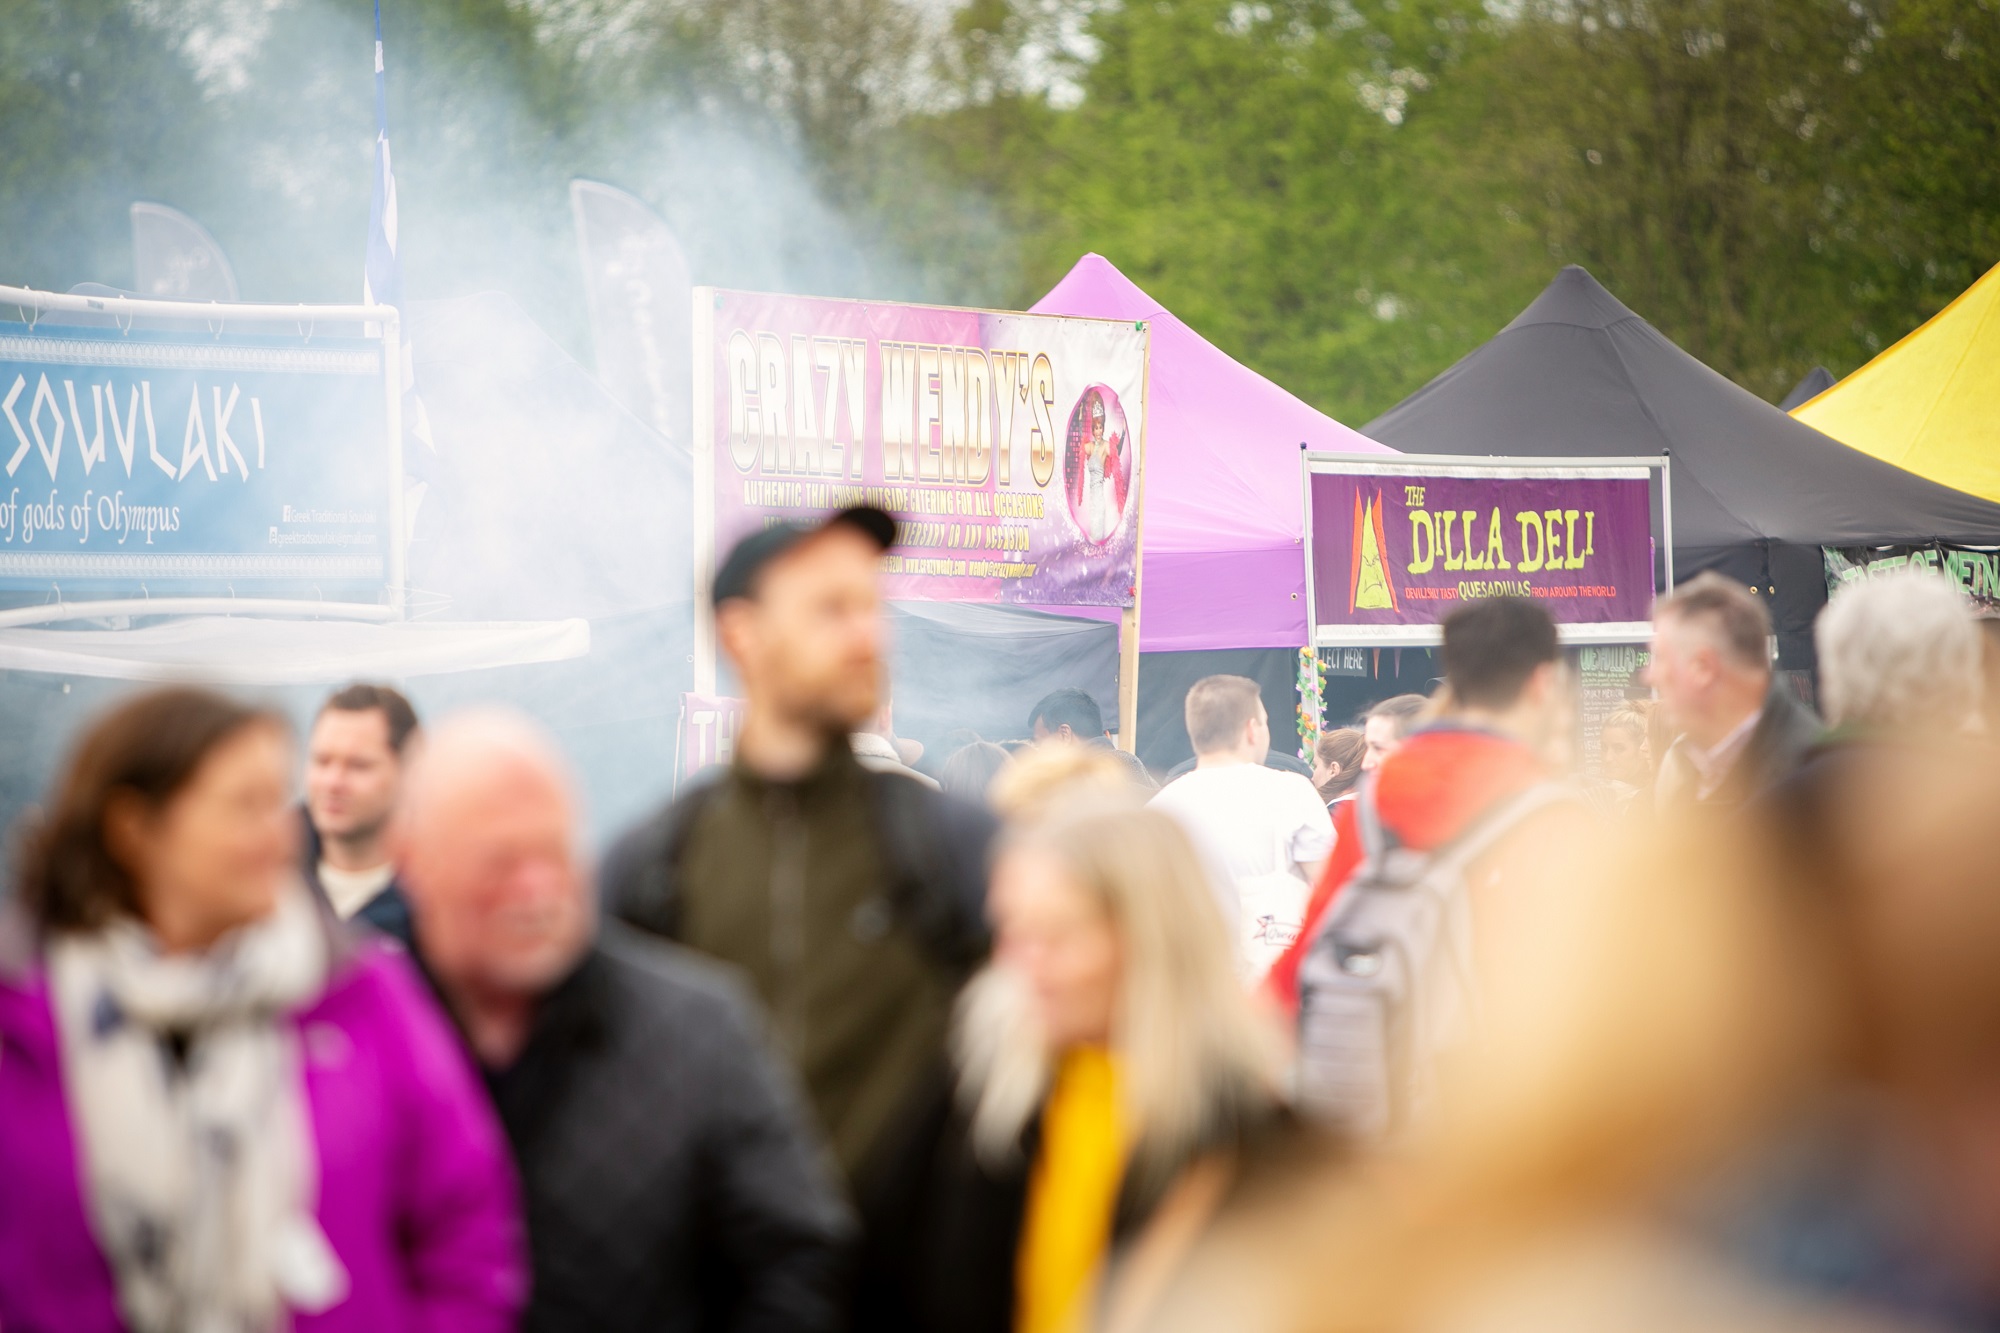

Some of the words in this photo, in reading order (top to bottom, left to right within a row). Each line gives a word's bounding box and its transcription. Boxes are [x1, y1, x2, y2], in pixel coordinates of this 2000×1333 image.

[728, 328, 867, 480] CRAZY
[879, 339, 1055, 488] WENDY'S
[2, 371, 265, 483] SOUVLAKI
[743, 480, 802, 507] AUTHENTIC
[805, 482, 829, 509] THAI
[832, 484, 864, 510] CUISINE
[866, 486, 908, 512] OUTSIDE
[910, 488, 954, 515] CATERING
[955, 490, 973, 517] FOR
[975, 491, 992, 517] ALL
[994, 492, 1045, 519] OCCASIONS
[1405, 485, 1425, 507] THE
[0, 487, 20, 543] of
[22, 488, 65, 544] gods
[71, 489, 93, 544] of
[97, 490, 180, 545] Olympus
[291, 508, 310, 523] Greek
[311, 508, 348, 523] Traditional
[947, 523, 961, 549] OR
[963, 523, 982, 550] ANY
[984, 524, 1030, 551] OCCASION
[1407, 506, 1512, 575] DILLA
[1515, 508, 1595, 574] DELI
[1439, 587, 1458, 600] TASTY
[1458, 580, 1531, 601] QUESADILLAS
[1549, 586, 1578, 598] AROUND
[1343, 648, 1363, 670] HERE
